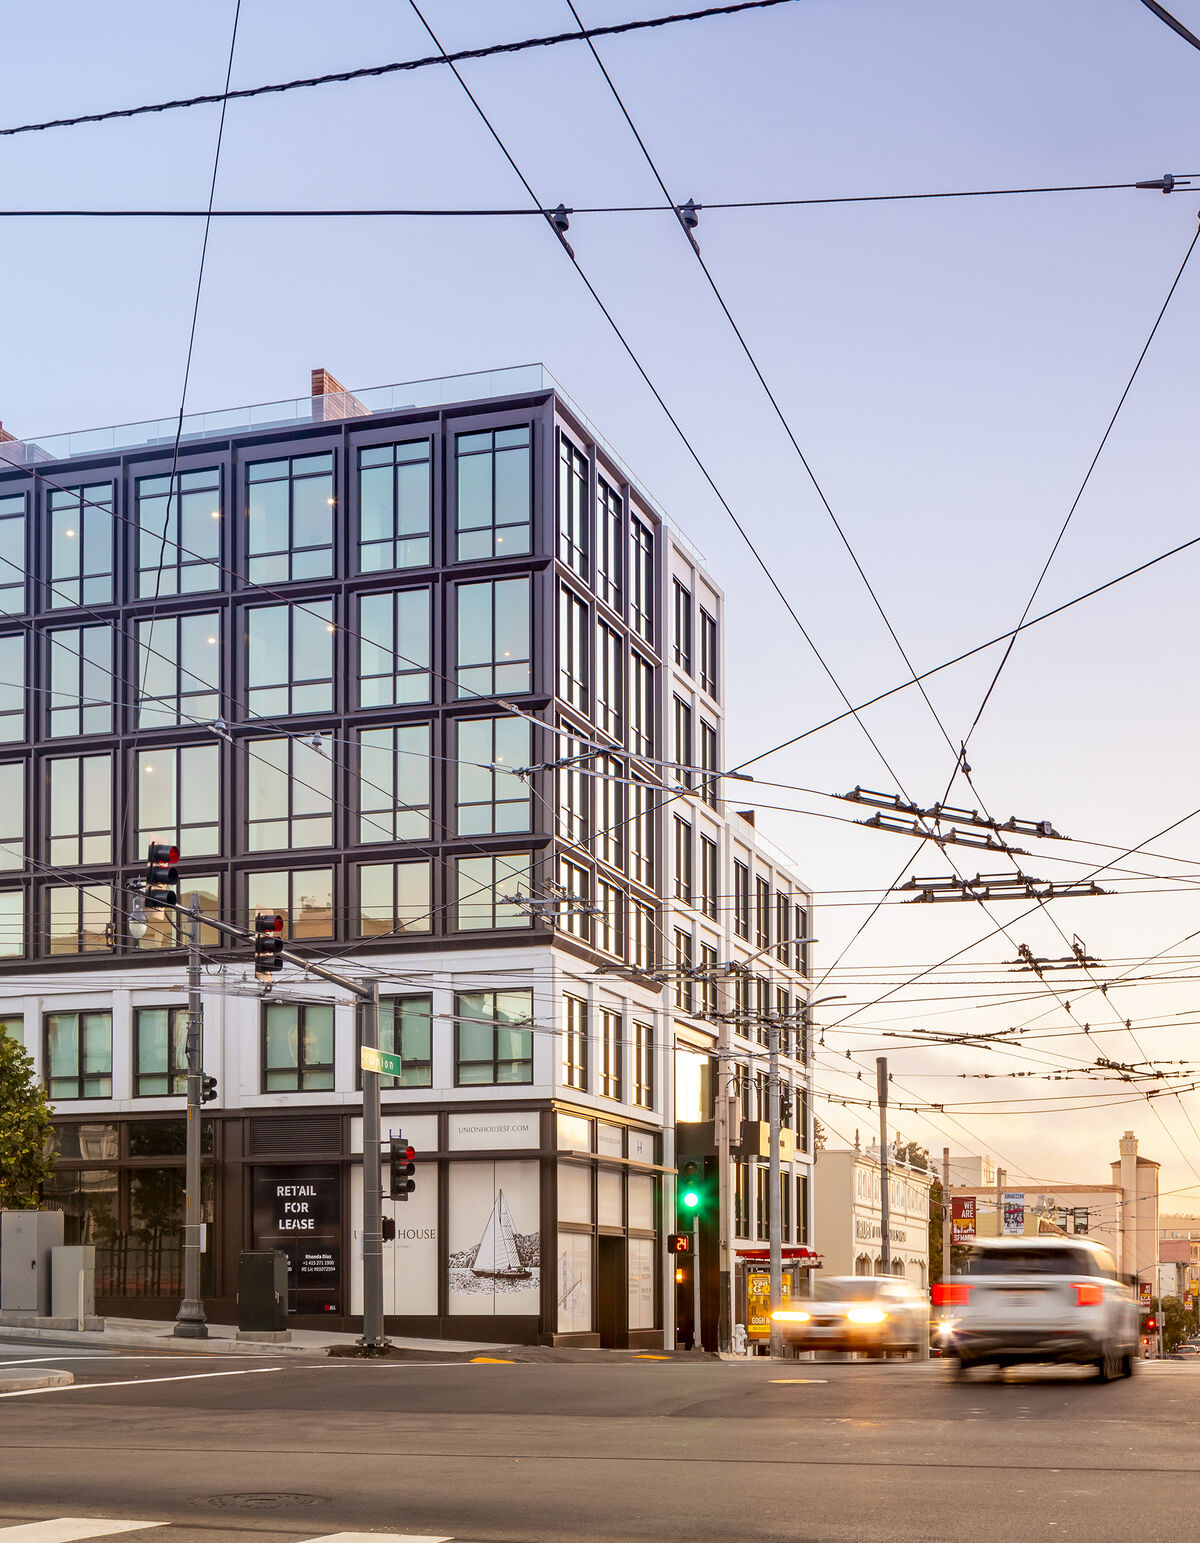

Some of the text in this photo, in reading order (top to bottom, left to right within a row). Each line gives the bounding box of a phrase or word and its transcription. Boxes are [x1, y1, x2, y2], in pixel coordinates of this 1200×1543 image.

[369, 1053, 393, 1070] Union
[458, 1124, 529, 1134] UNIONHOUSESF.COM
[276, 1185, 316, 1197] RETAIL
[284, 1202, 309, 1213] FOR
[963, 1201, 974, 1209] WE
[961, 1209, 974, 1218] ARE
[278, 1219, 314, 1230] LEASE
[397, 1229, 436, 1240] HOUSE
[677, 1237, 687, 1250] 24
